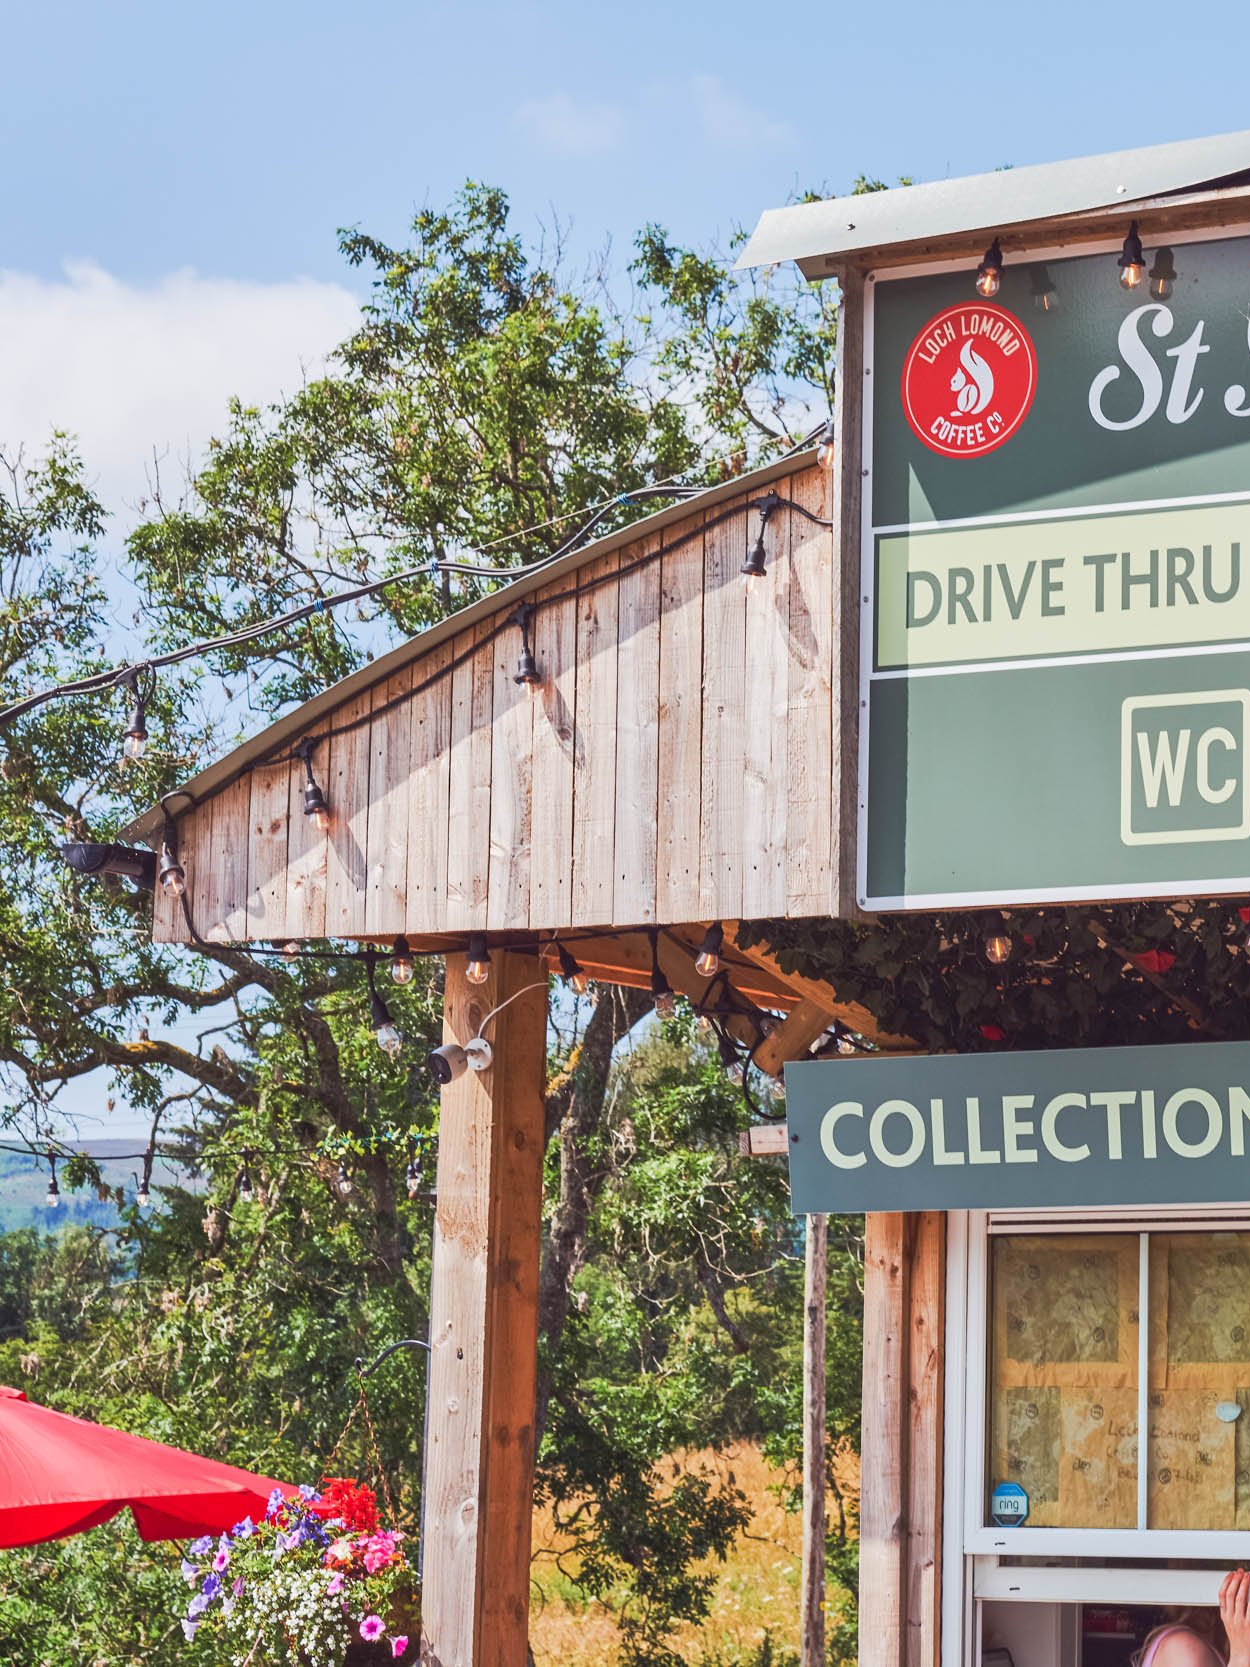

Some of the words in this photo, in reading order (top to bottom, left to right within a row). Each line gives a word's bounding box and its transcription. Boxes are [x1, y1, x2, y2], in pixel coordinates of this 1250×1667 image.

[918, 321, 957, 364] LOCH
[961, 314, 1020, 356] LOMOND
[1088, 303, 1211, 431] St
[930, 416, 986, 445] COFFEE
[906, 557, 1066, 629] DRIVE
[1083, 541, 1241, 613] THRU
[1136, 727, 1237, 808] WC
[1000, 1498, 1019, 1512] ring
